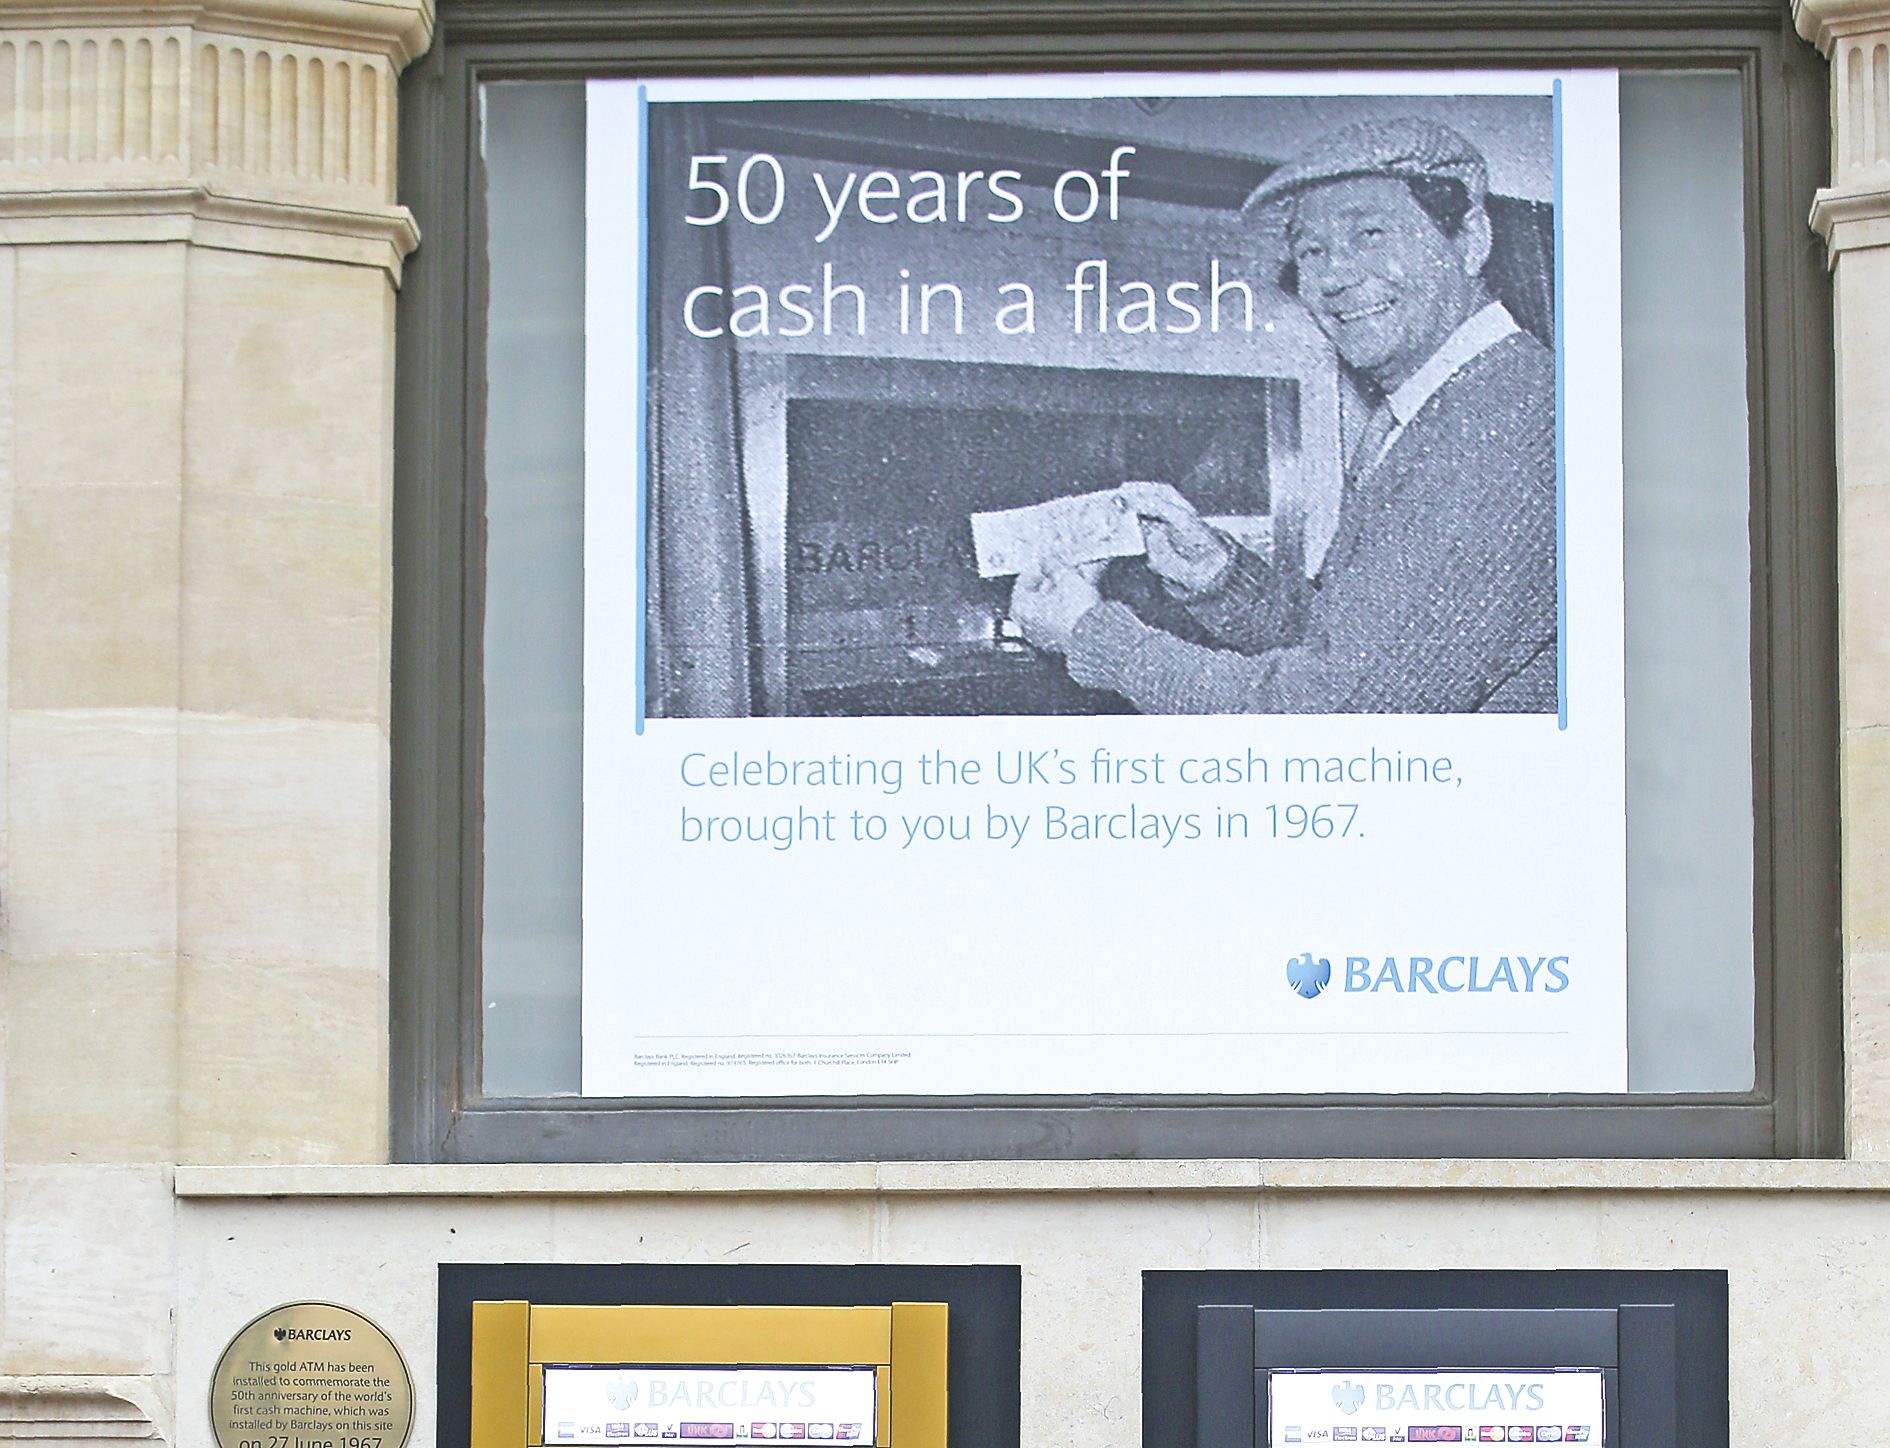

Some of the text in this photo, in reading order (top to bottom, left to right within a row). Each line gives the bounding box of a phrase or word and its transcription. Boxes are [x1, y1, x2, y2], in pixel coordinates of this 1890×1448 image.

[685, 145, 1135, 242] 50 years of
[683, 259, 1277, 338] cash in a flash.
[680, 749, 1463, 795] Celebrating the UK's first cash machine,
[681, 805, 1364, 851] brought to you by Barclays in 1967.
[1344, 956, 1570, 994] BARCLAYS
[288, 1330, 351, 1340] BARCLAYS
[249, 1362, 374, 1373] This gold ATM has been
[233, 1377, 390, 1387] installed to commemorate the
[231, 1391, 392, 1403] 50th anniversary of the world's
[648, 1380, 815, 1409] BARCLAYS
[1376, 1383, 1544, 1411] BARCLAYS
[234, 1405, 253, 1415] first
[257, 1405, 280, 1415] cash
[284, 1406, 331, 1416] machine,
[334, 1406, 365, 1415] which
[230, 1420, 272, 1429] installed
[275, 1420, 287, 1431] by
[290, 1420, 333, 1432] Barclays
[352, 1422, 372, 1430] this
[374, 1422, 392, 1430] site
[580, 1425, 601, 1434] VISA
[1307, 1430, 1328, 1438] VISA
